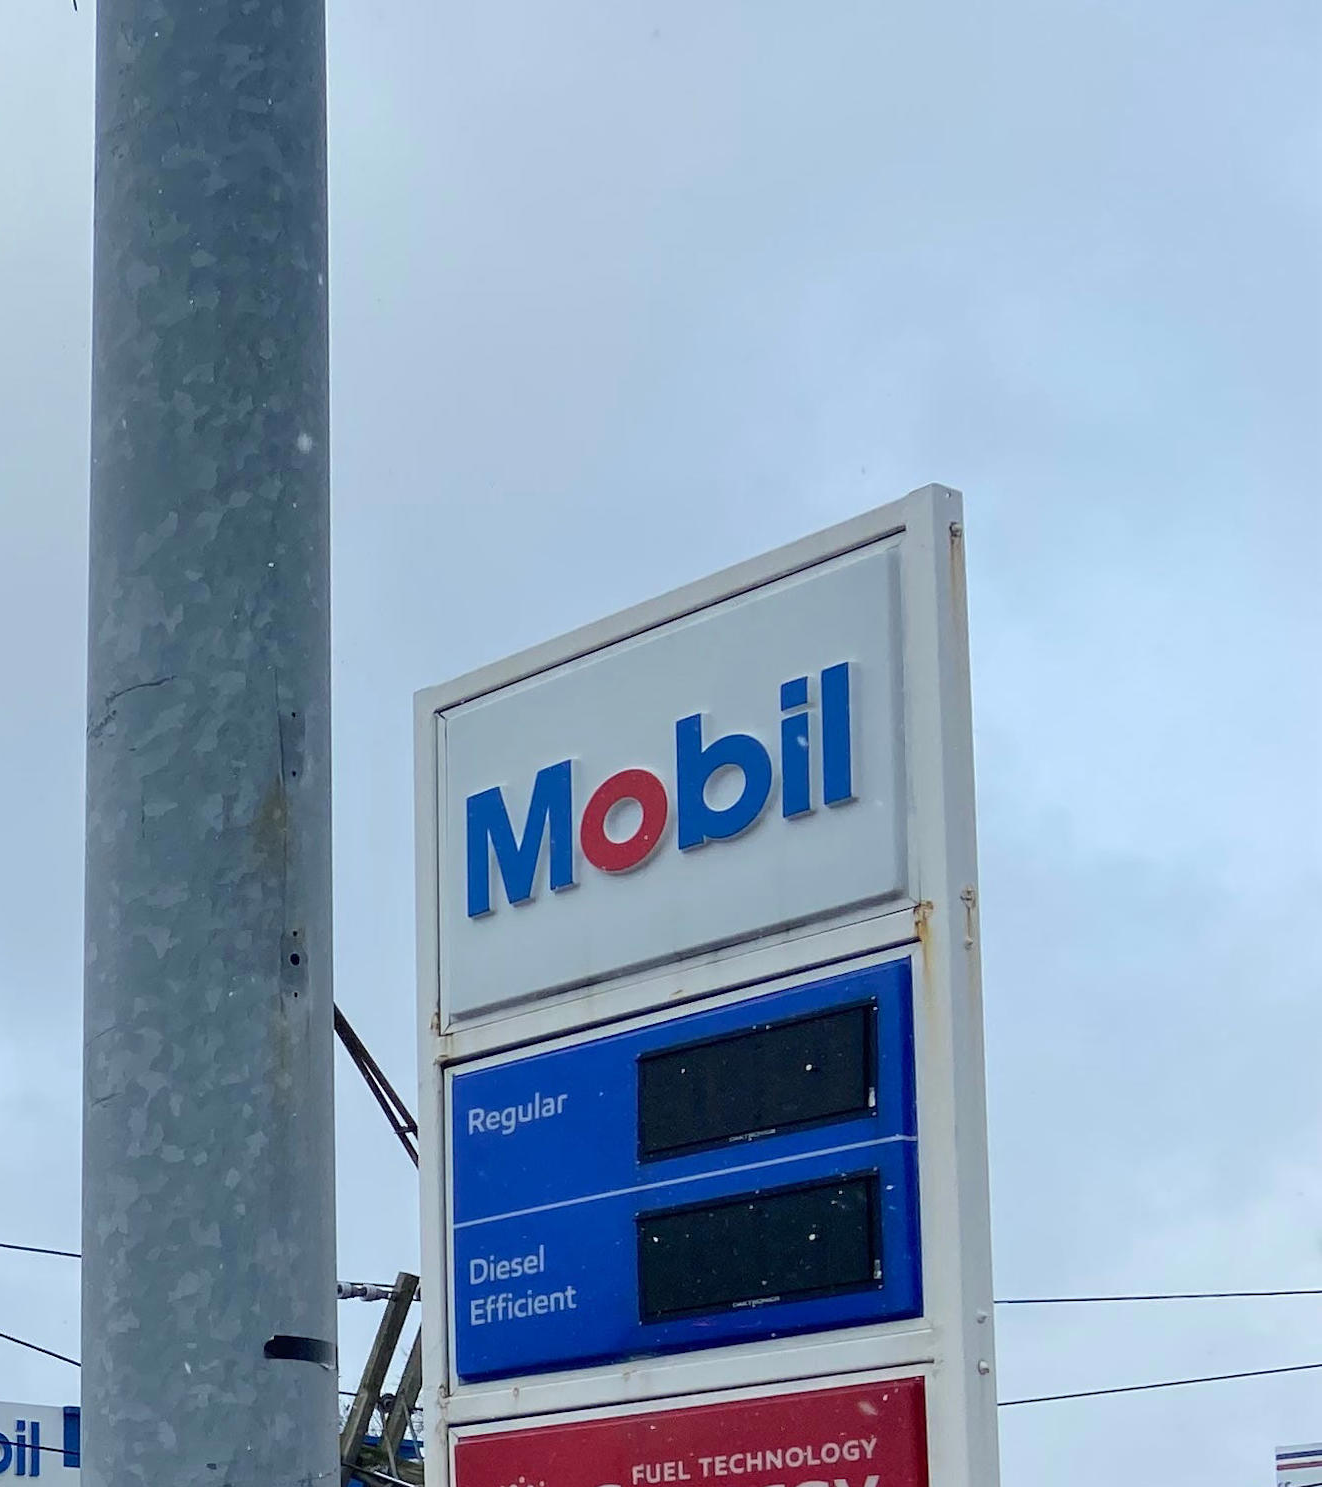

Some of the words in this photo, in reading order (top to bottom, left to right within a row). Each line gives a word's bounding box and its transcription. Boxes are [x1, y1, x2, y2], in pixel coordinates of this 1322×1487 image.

[466, 661, 854, 919] Mobil
[468, 1091, 568, 1136] Regular
[469, 1243, 545, 1286] Diesel
[470, 1285, 578, 1327] Efficient
[631, 1459, 691, 1486] FUEL
[698, 1437, 878, 1478] TECHNOLOGY
